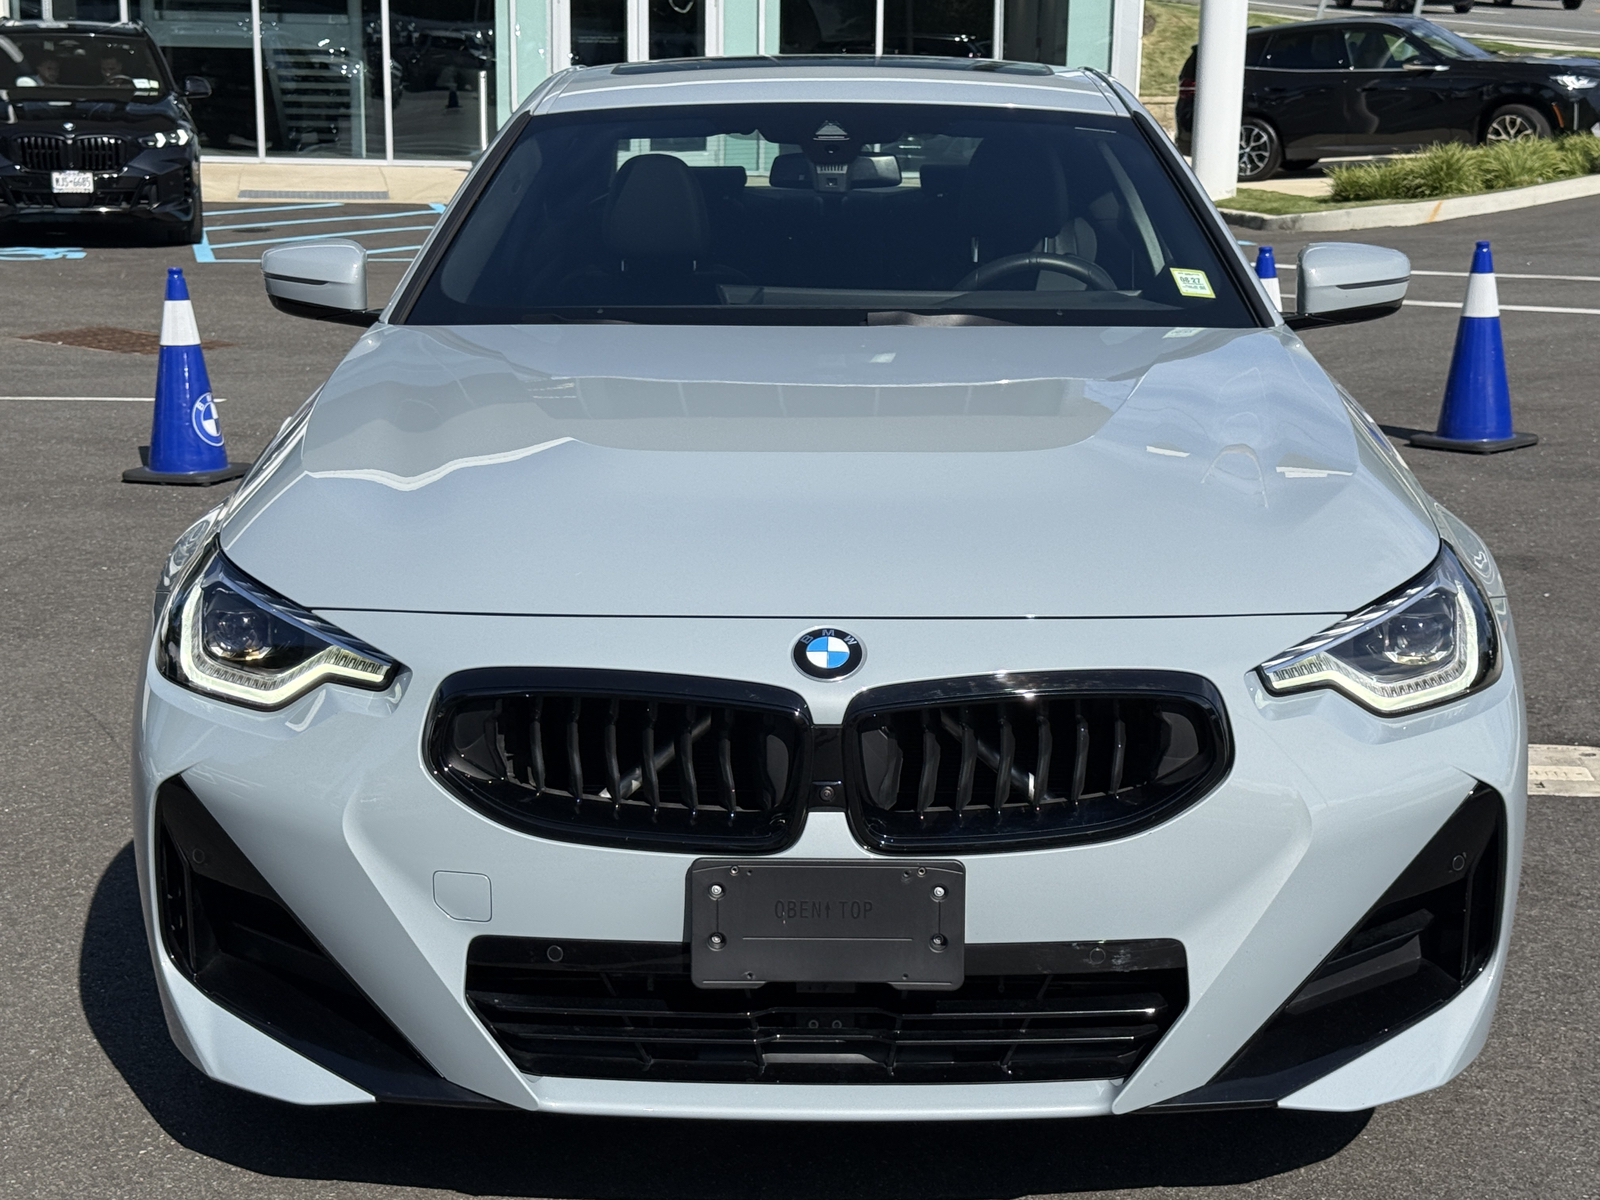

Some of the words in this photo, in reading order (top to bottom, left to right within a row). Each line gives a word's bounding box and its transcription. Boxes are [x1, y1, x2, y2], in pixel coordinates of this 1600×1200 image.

[800, 629, 858, 646] BMW
[774, 900, 822, 919] OBEN
[838, 900, 874, 920] TOP
